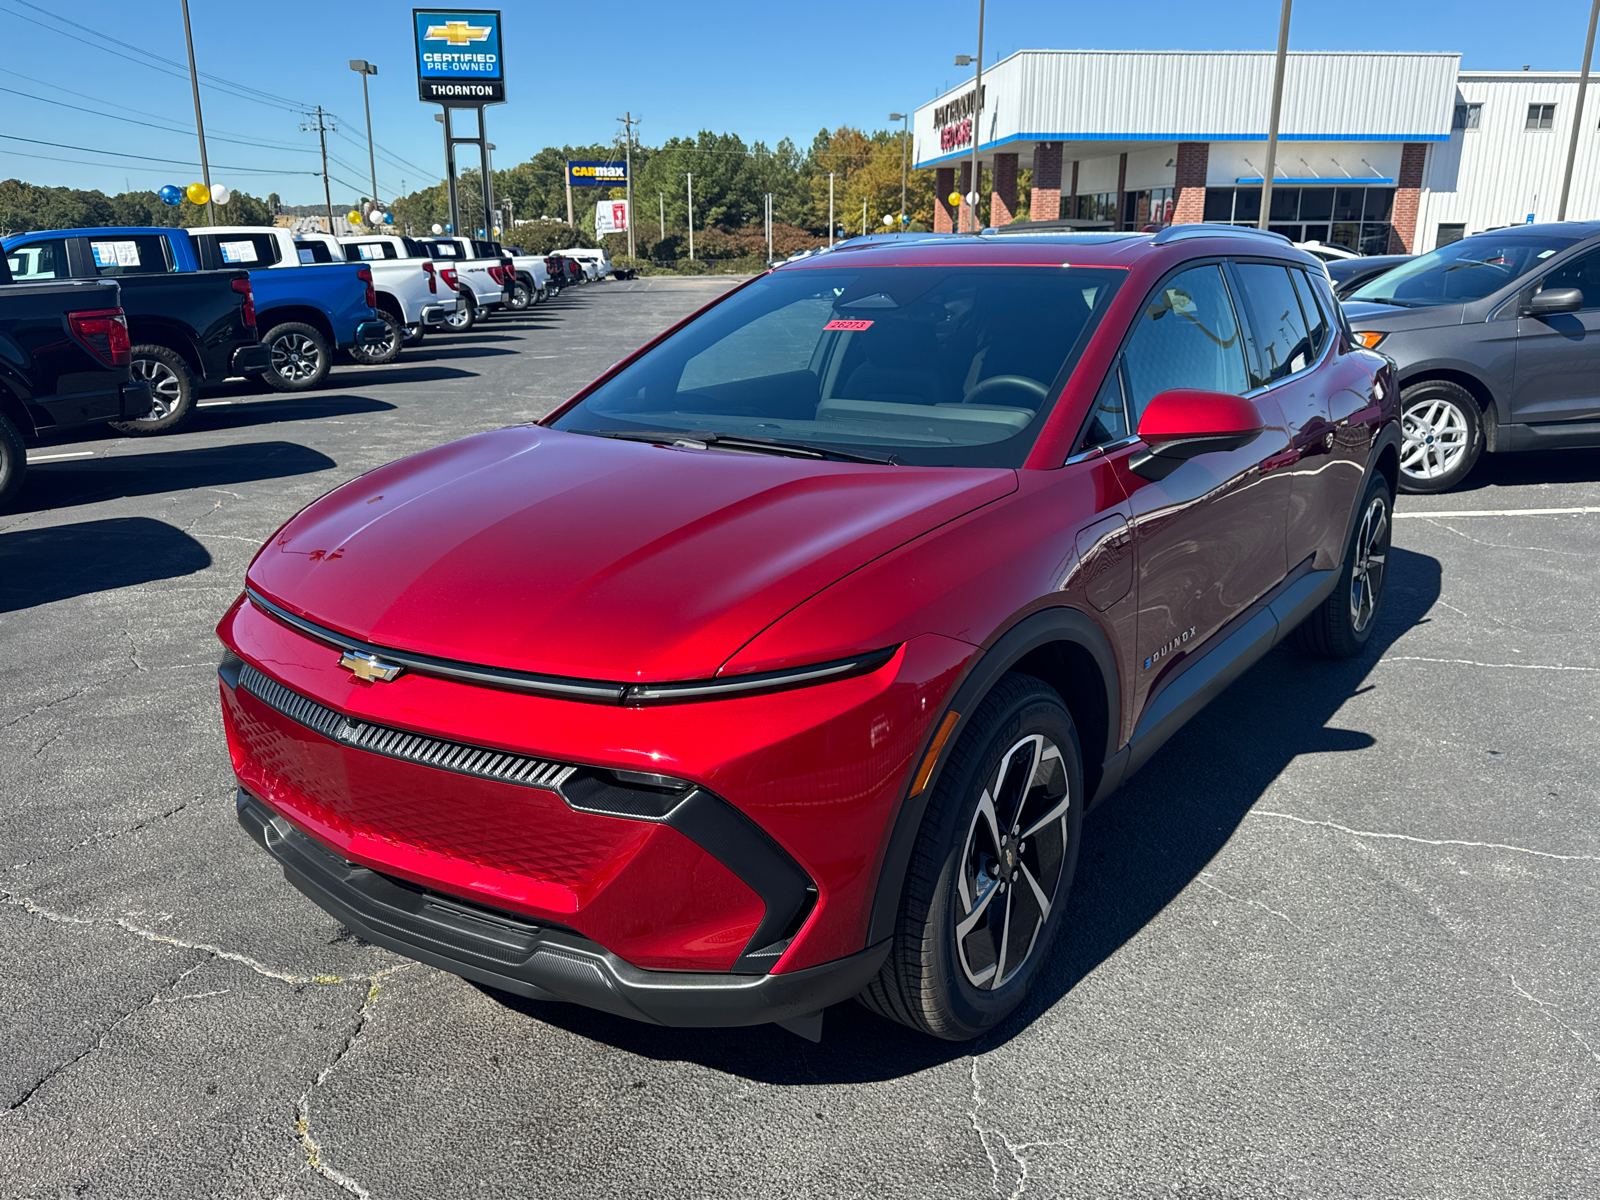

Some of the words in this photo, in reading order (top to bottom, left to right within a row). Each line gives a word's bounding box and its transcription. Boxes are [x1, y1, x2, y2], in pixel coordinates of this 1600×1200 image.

[423, 53, 497, 63] CERTIFIED
[427, 62, 493, 71] PRE-OWNED
[431, 85, 493, 96] THORNTON
[831, 321, 866, 329] 26273
[1144, 626, 1196, 670] EQUINOX
